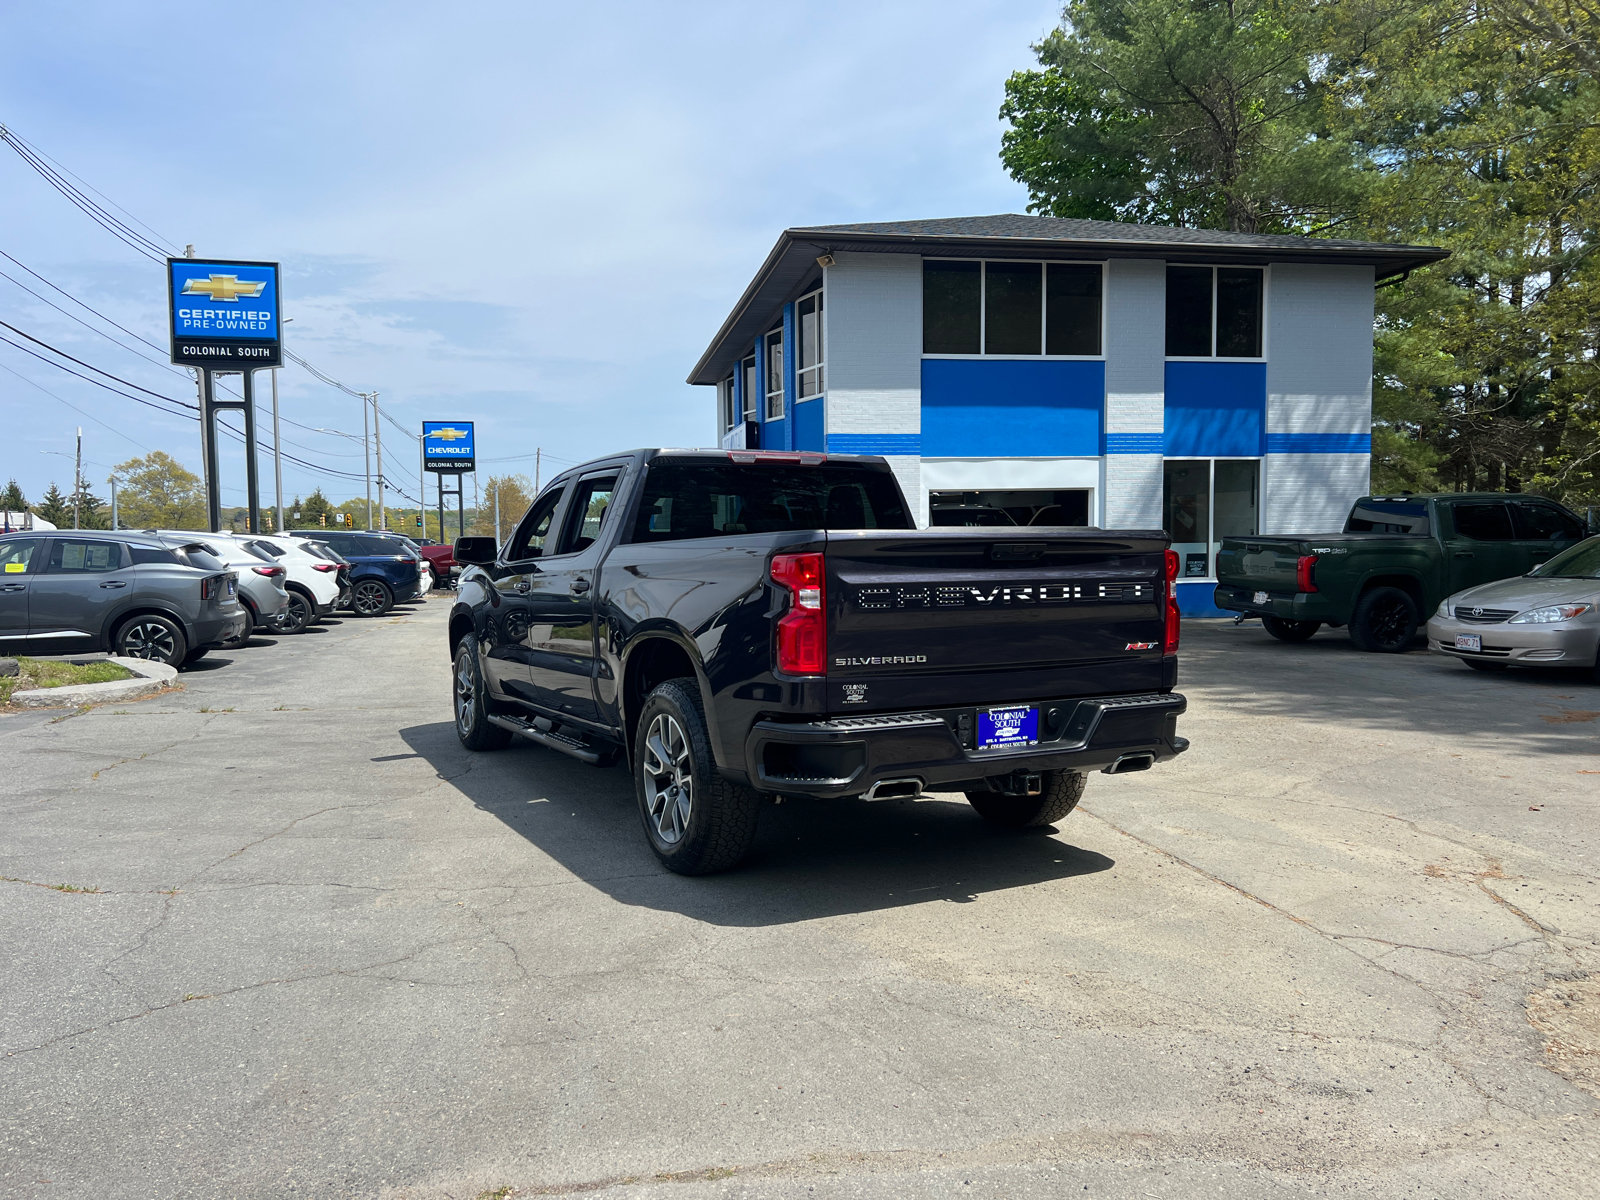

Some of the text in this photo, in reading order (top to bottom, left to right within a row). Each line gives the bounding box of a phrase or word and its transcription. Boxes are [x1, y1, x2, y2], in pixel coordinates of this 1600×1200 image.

[178, 309, 271, 320] CERTIFIED
[183, 319, 267, 330] PRE-OWNED
[182, 346, 270, 357] COLONIAL SOUTH
[858, 582, 1153, 608] CHEVROLET
[1124, 641, 1159, 651] RST
[1472, 638, 1479, 647] 71
[835, 654, 927, 667] SILVERADO
[990, 711, 1027, 721] COLONIAL
[995, 719, 1020, 728] SOUTH
